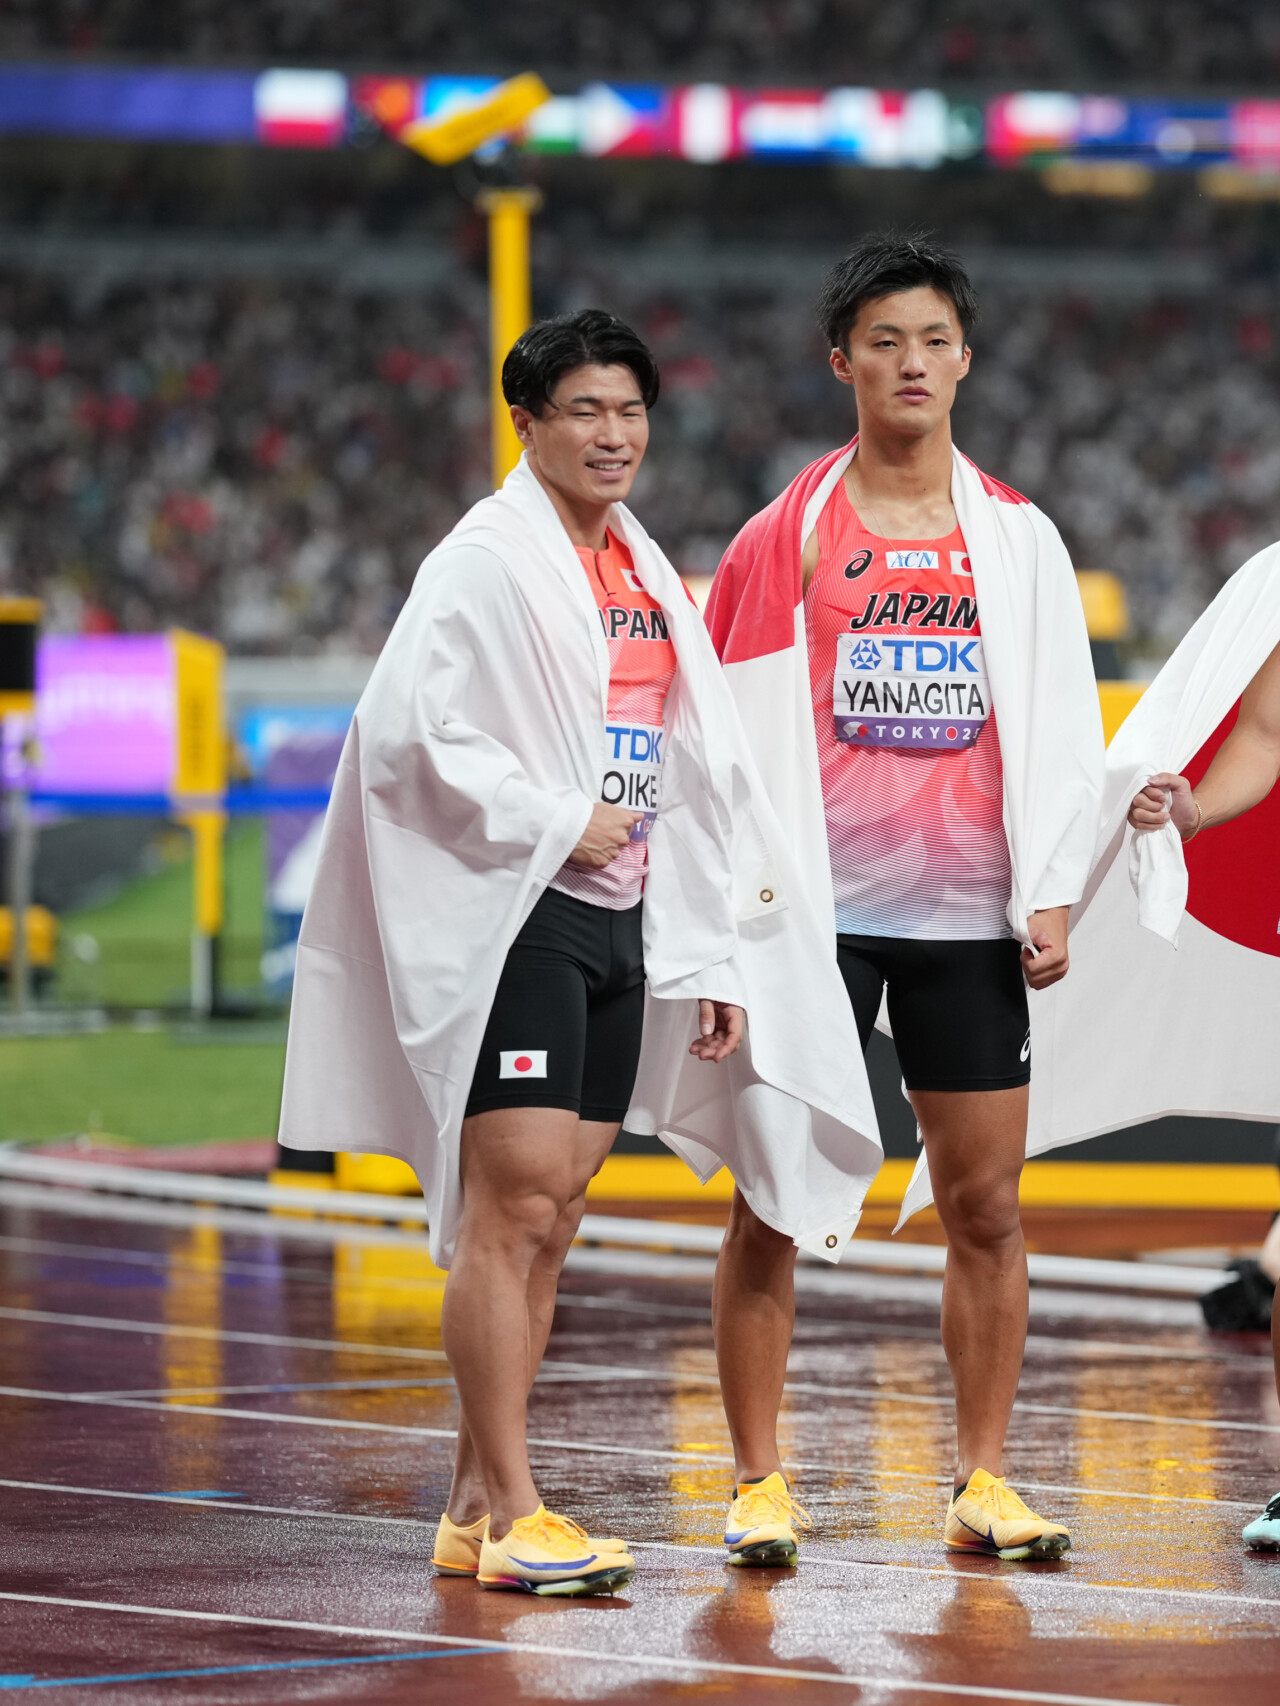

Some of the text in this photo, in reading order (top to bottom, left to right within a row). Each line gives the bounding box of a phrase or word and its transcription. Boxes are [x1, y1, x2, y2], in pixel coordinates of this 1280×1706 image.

[891, 552, 935, 568] ACN
[597, 608, 669, 641] PAN
[850, 592, 978, 630] JAPAN
[882, 640, 979, 673] TDK
[842, 680, 985, 716] YANAGITA
[605, 726, 663, 764] TDK
[601, 771, 657, 808] OIKE
